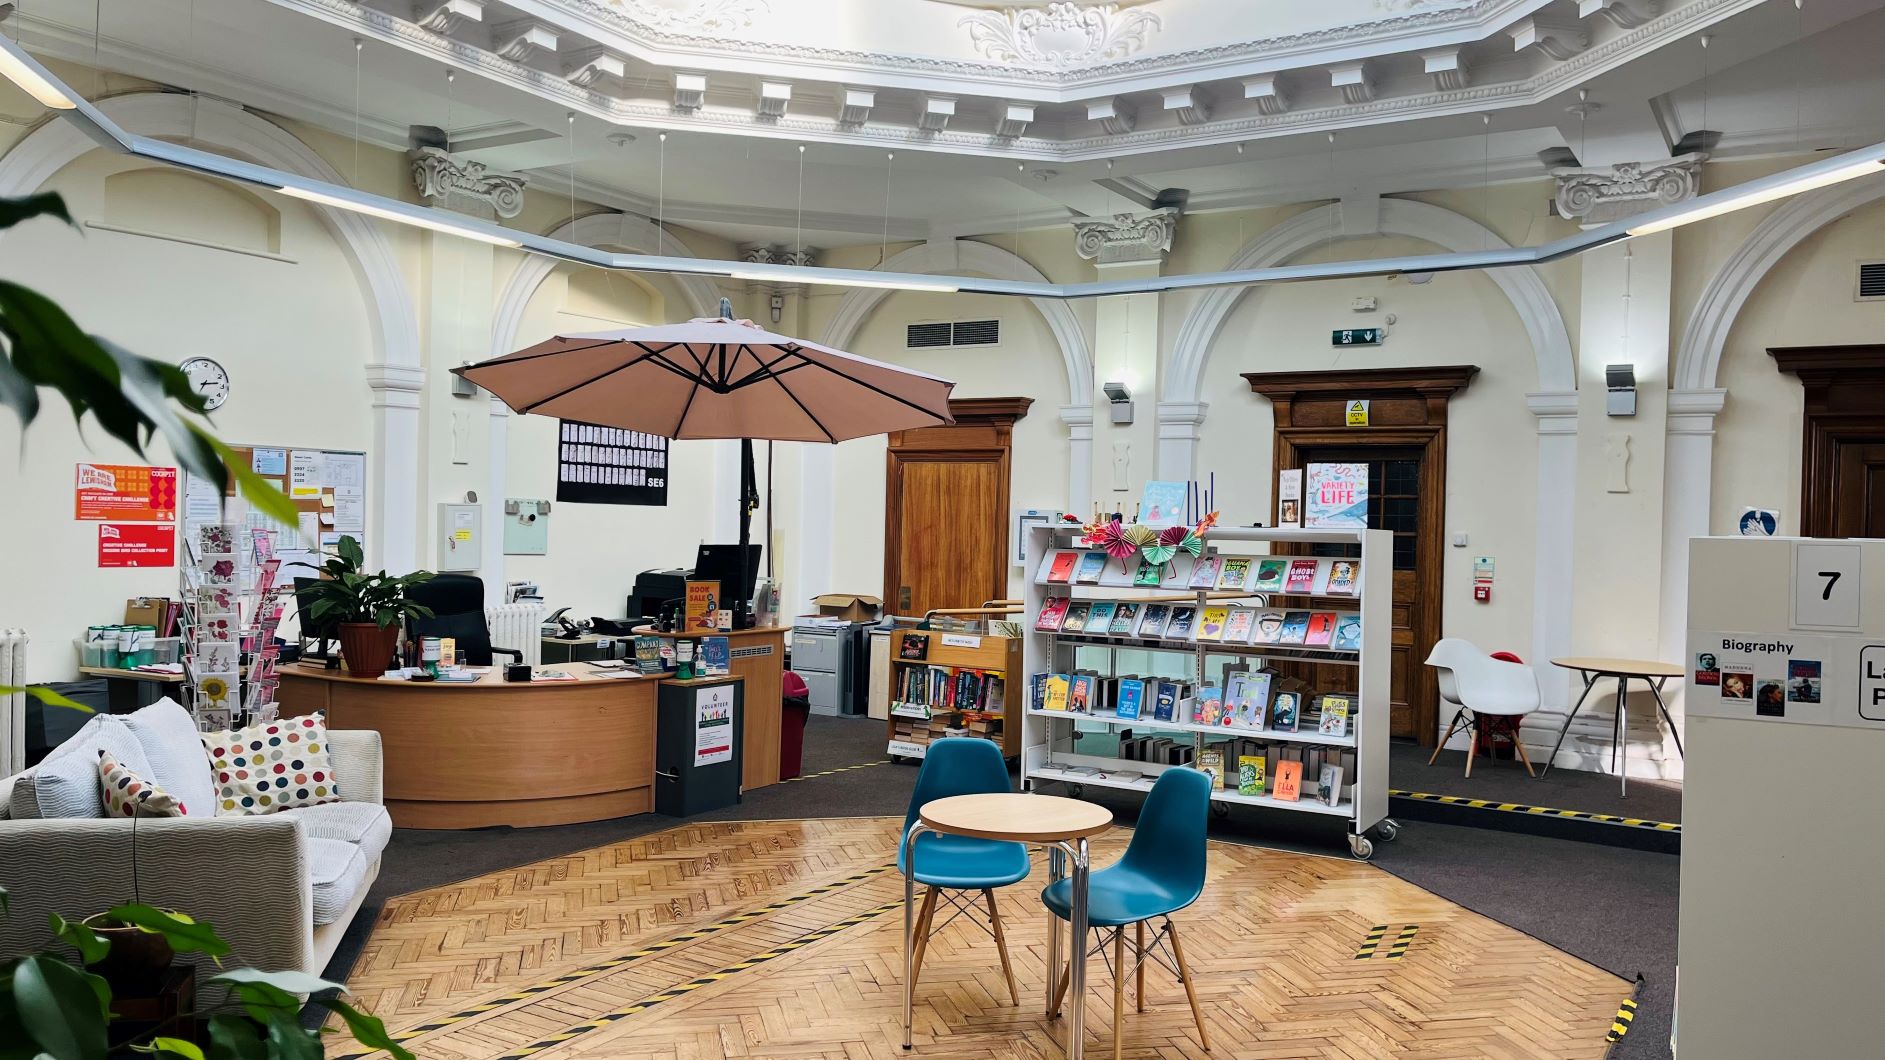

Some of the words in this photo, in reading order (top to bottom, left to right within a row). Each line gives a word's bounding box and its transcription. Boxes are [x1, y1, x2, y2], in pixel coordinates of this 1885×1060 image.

[82, 468, 96, 477] WE
[97, 471, 111, 481] ARE
[647, 477, 665, 488] SE6
[1321, 481, 1355, 490] VARIETY
[1320, 490, 1355, 505] LIFE
[1290, 567, 1315, 575] GHOST
[1818, 571, 1841, 600] 7
[689, 594, 706, 602] SALE
[1722, 639, 1794, 655] Biography
[1867, 661, 1885, 679] L
